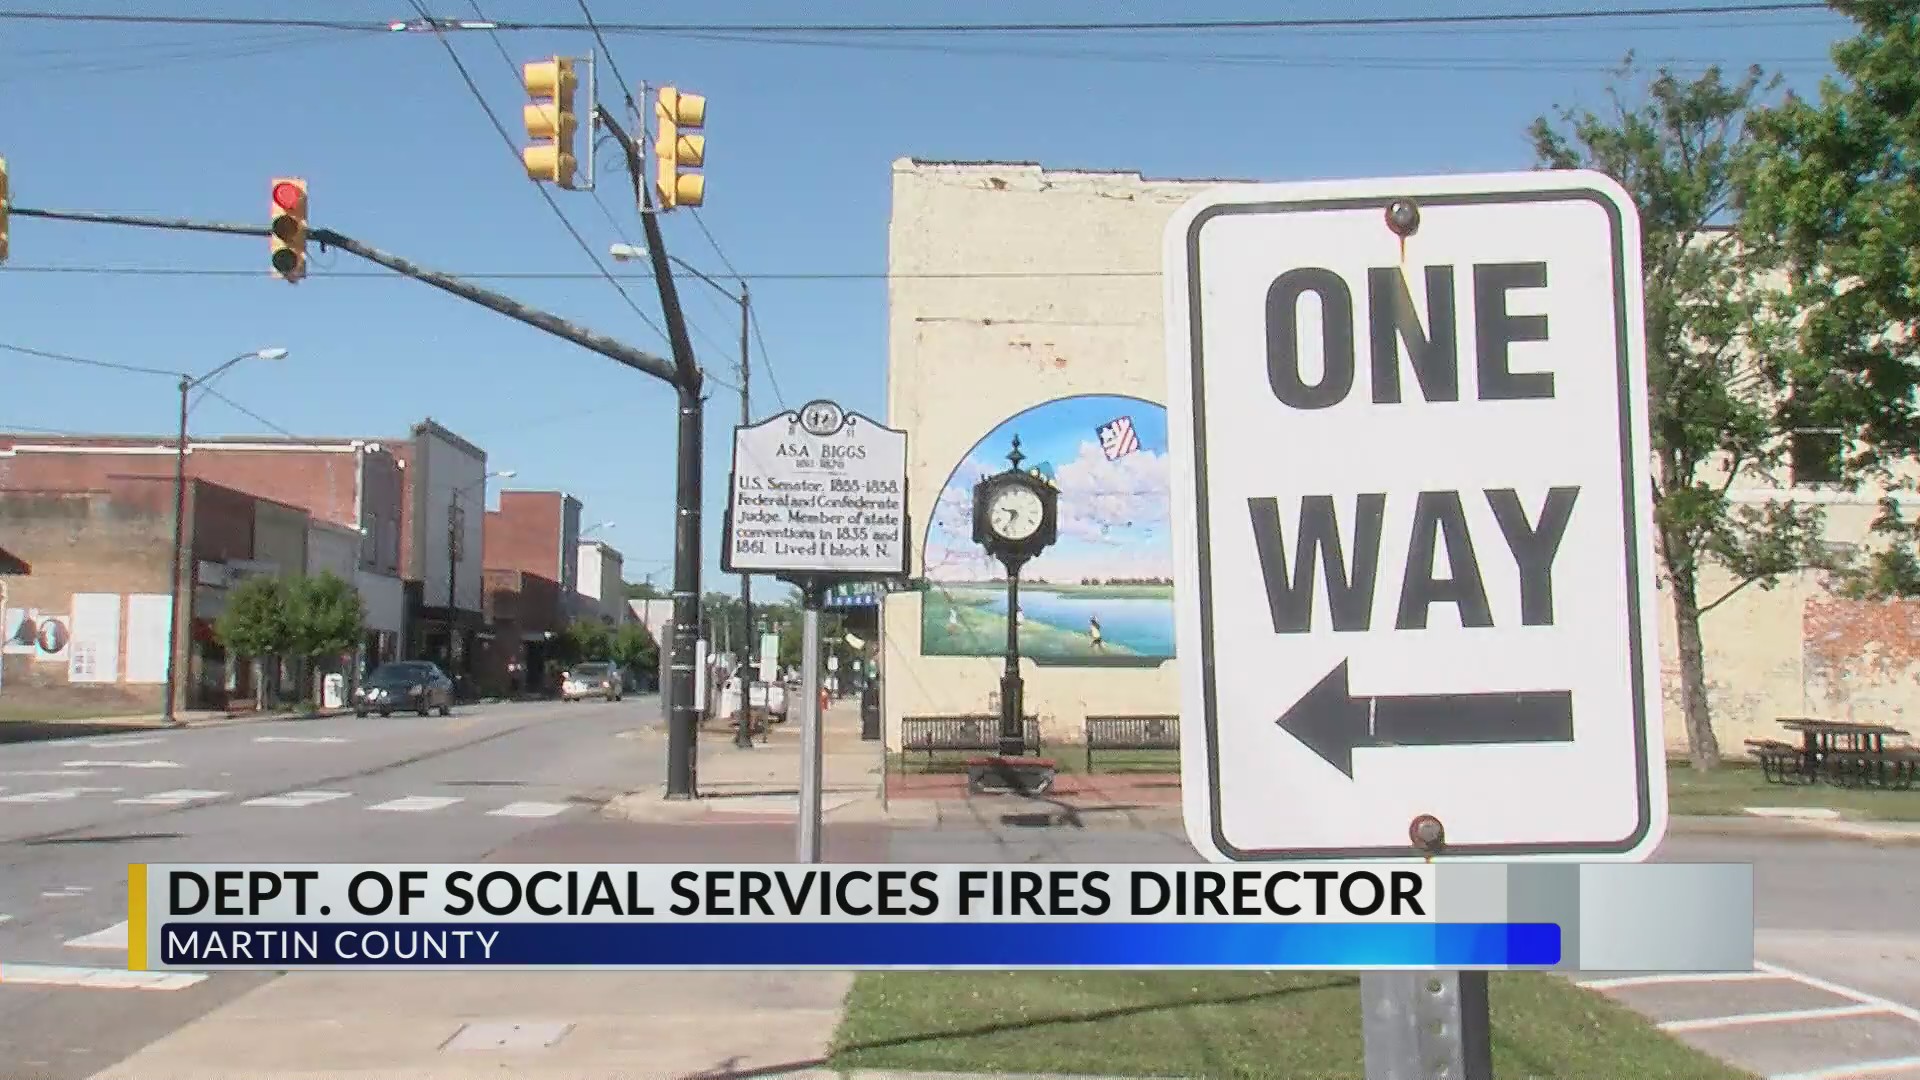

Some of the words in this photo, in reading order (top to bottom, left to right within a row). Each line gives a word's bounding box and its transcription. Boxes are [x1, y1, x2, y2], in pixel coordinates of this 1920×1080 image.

[1265, 261, 1556, 410] ONE
[775, 443, 810, 459] ASA
[822, 443, 867, 460] BIGGS
[737, 492, 789, 507] Federal
[790, 495, 816, 508] and
[816, 495, 900, 510] Confederate
[787, 510, 845, 525] Member
[847, 511, 863, 524] of
[863, 513, 899, 527] state
[735, 527, 816, 541] conventions
[818, 529, 833, 541] in
[837, 527, 868, 541] 1835
[872, 528, 898, 542] and
[775, 541, 817, 556] Lived
[829, 543, 871, 558] block
[1247, 485, 1581, 634] WAY
